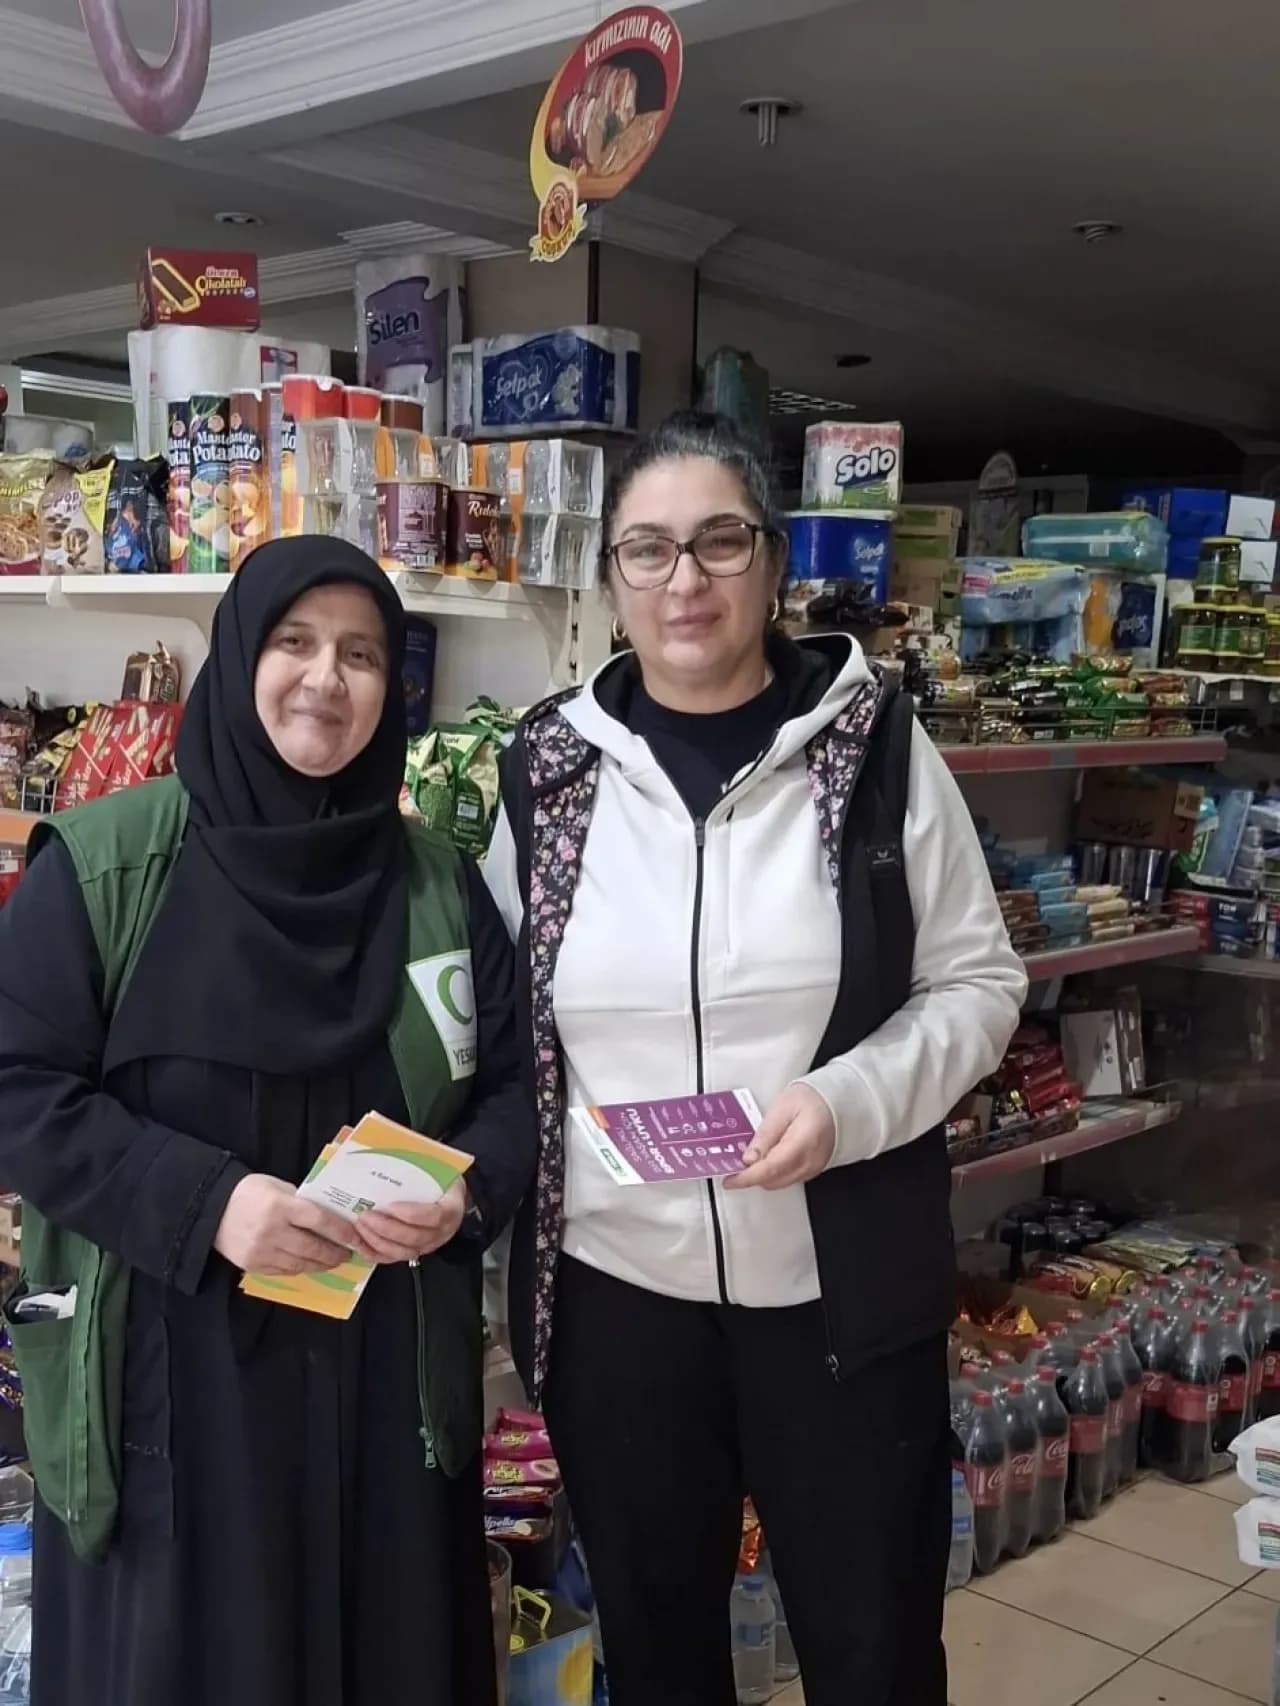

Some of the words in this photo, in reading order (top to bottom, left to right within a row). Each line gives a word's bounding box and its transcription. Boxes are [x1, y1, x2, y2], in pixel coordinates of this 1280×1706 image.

[585, 15, 649, 68] kırmızının
[649, 20, 673, 55] adı
[368, 310, 420, 345] Silen
[495, 365, 544, 400] Selpak
[836, 447, 896, 486] Solo
